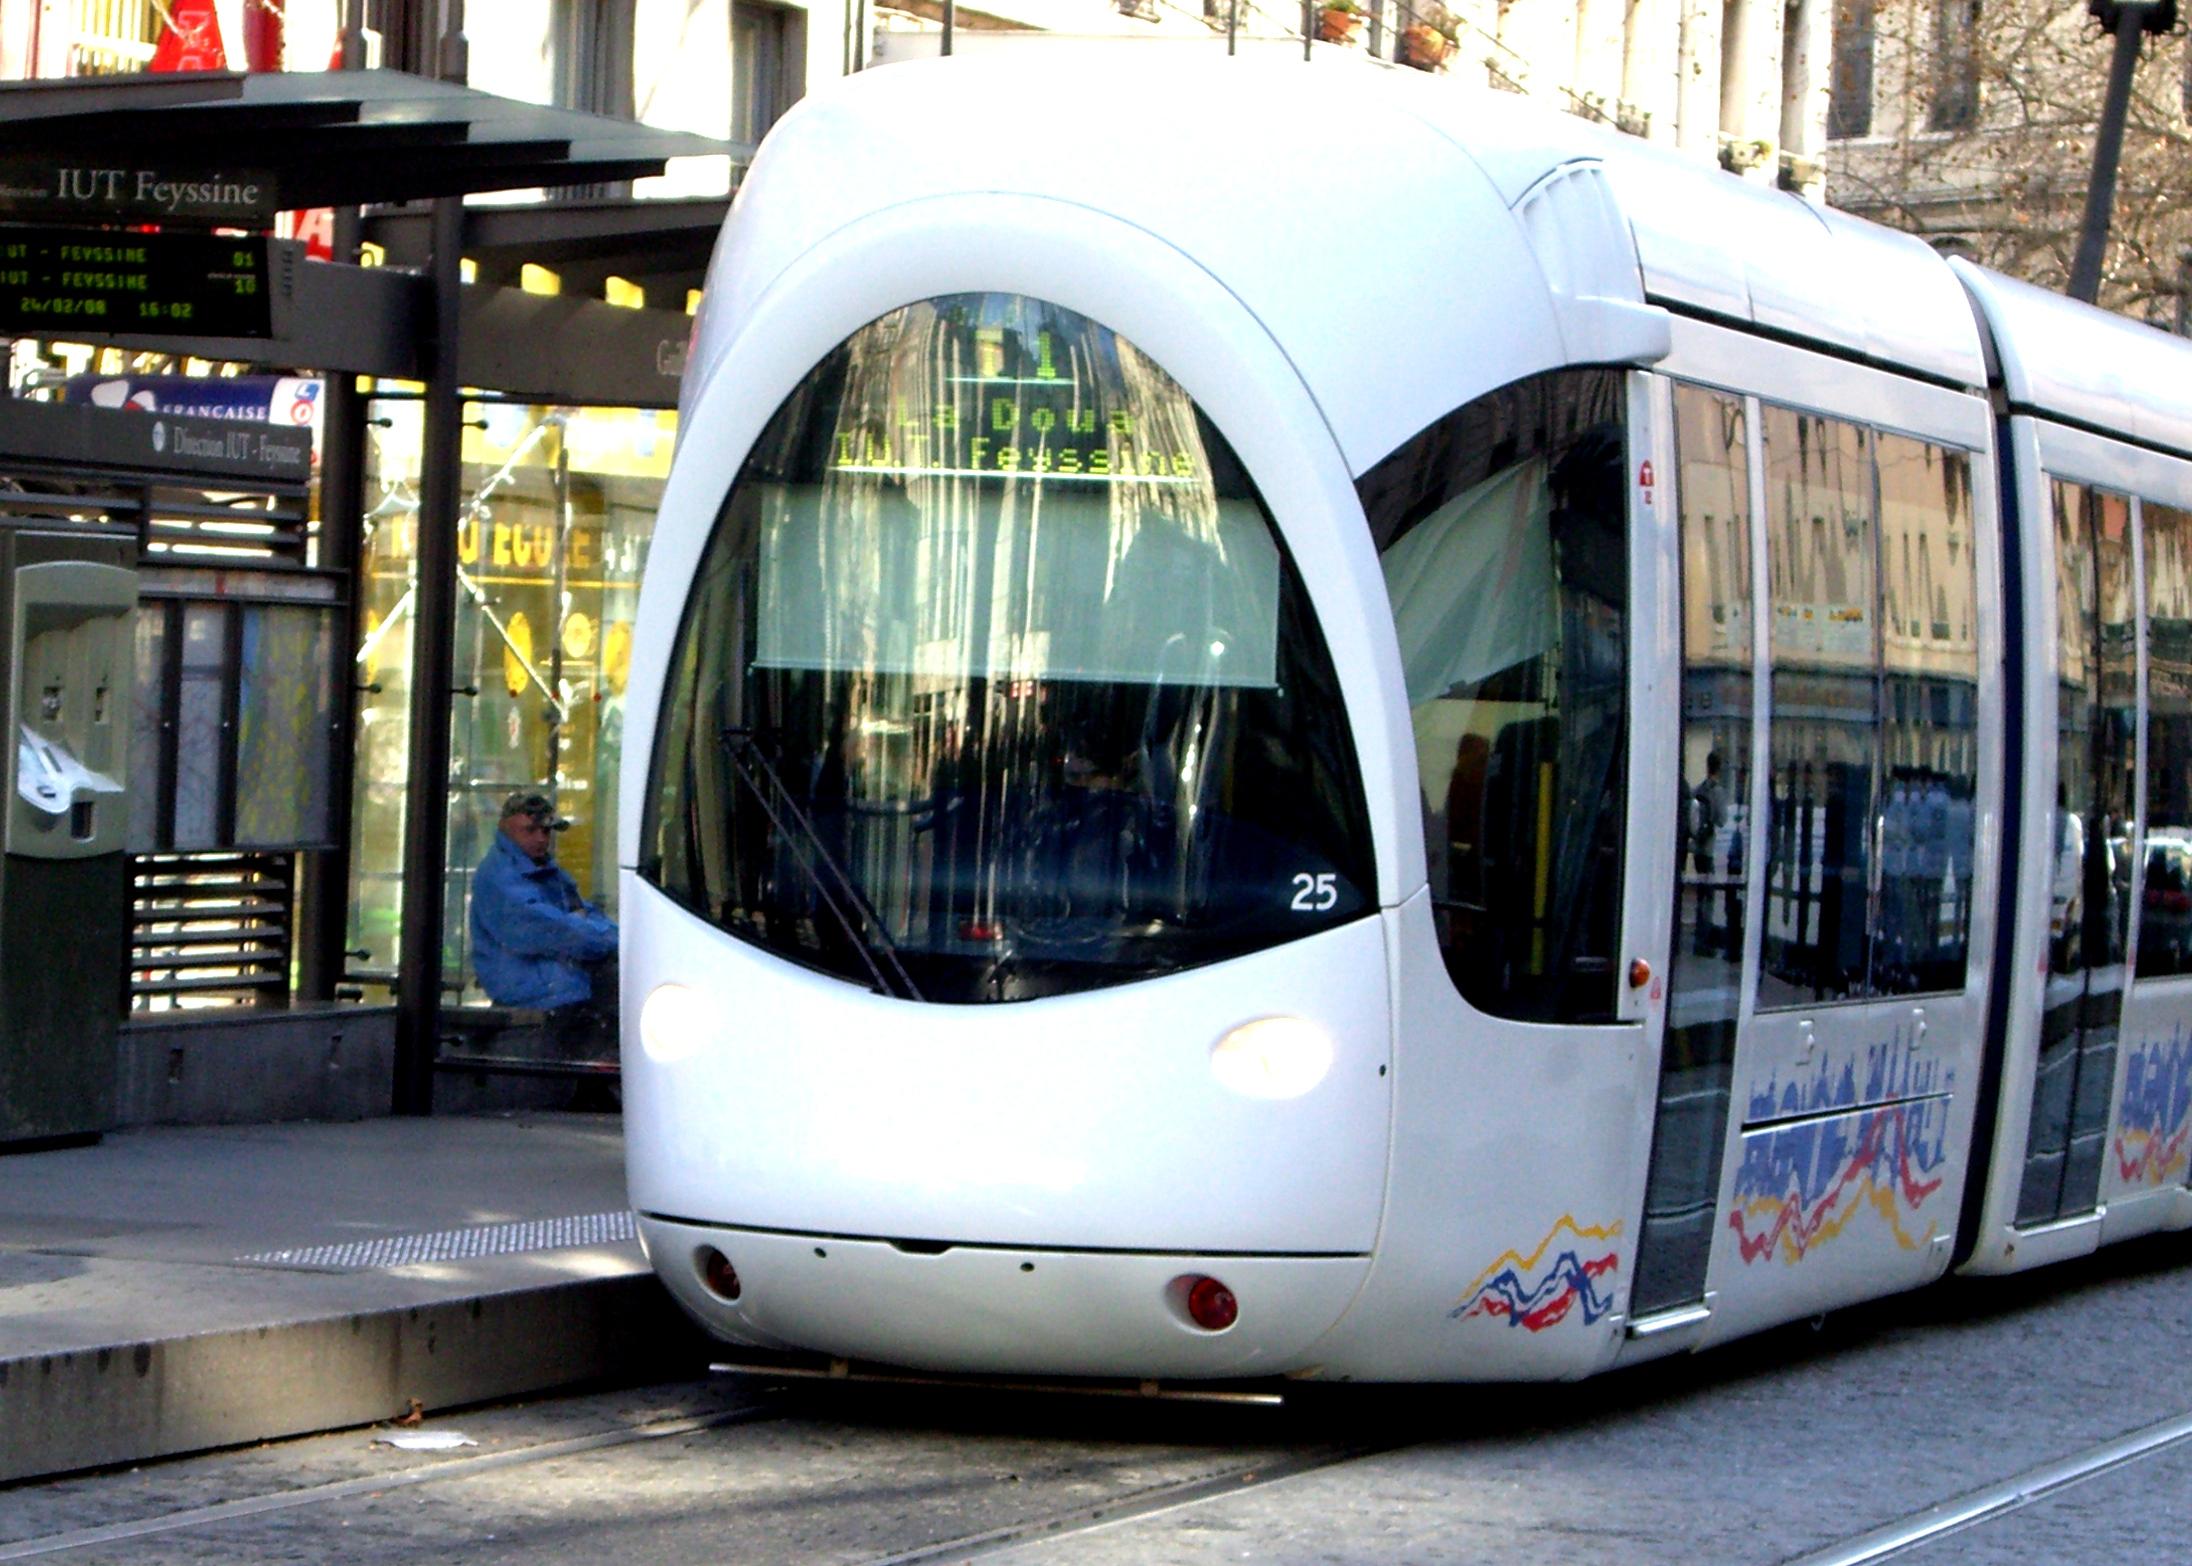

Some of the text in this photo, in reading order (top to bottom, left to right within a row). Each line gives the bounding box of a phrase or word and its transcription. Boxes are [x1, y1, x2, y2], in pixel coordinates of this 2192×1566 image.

[57, 168, 126, 200] IUT
[135, 171, 259, 212] Feyssine
[61, 246, 147, 262] FEYSSINE
[62, 272, 147, 289] FEYSSINE
[899, 397, 1136, 435] La Doua
[226, 431, 250, 461] IUT
[971, 436, 1194, 478] Feyssine
[1290, 872, 1338, 911] 25
